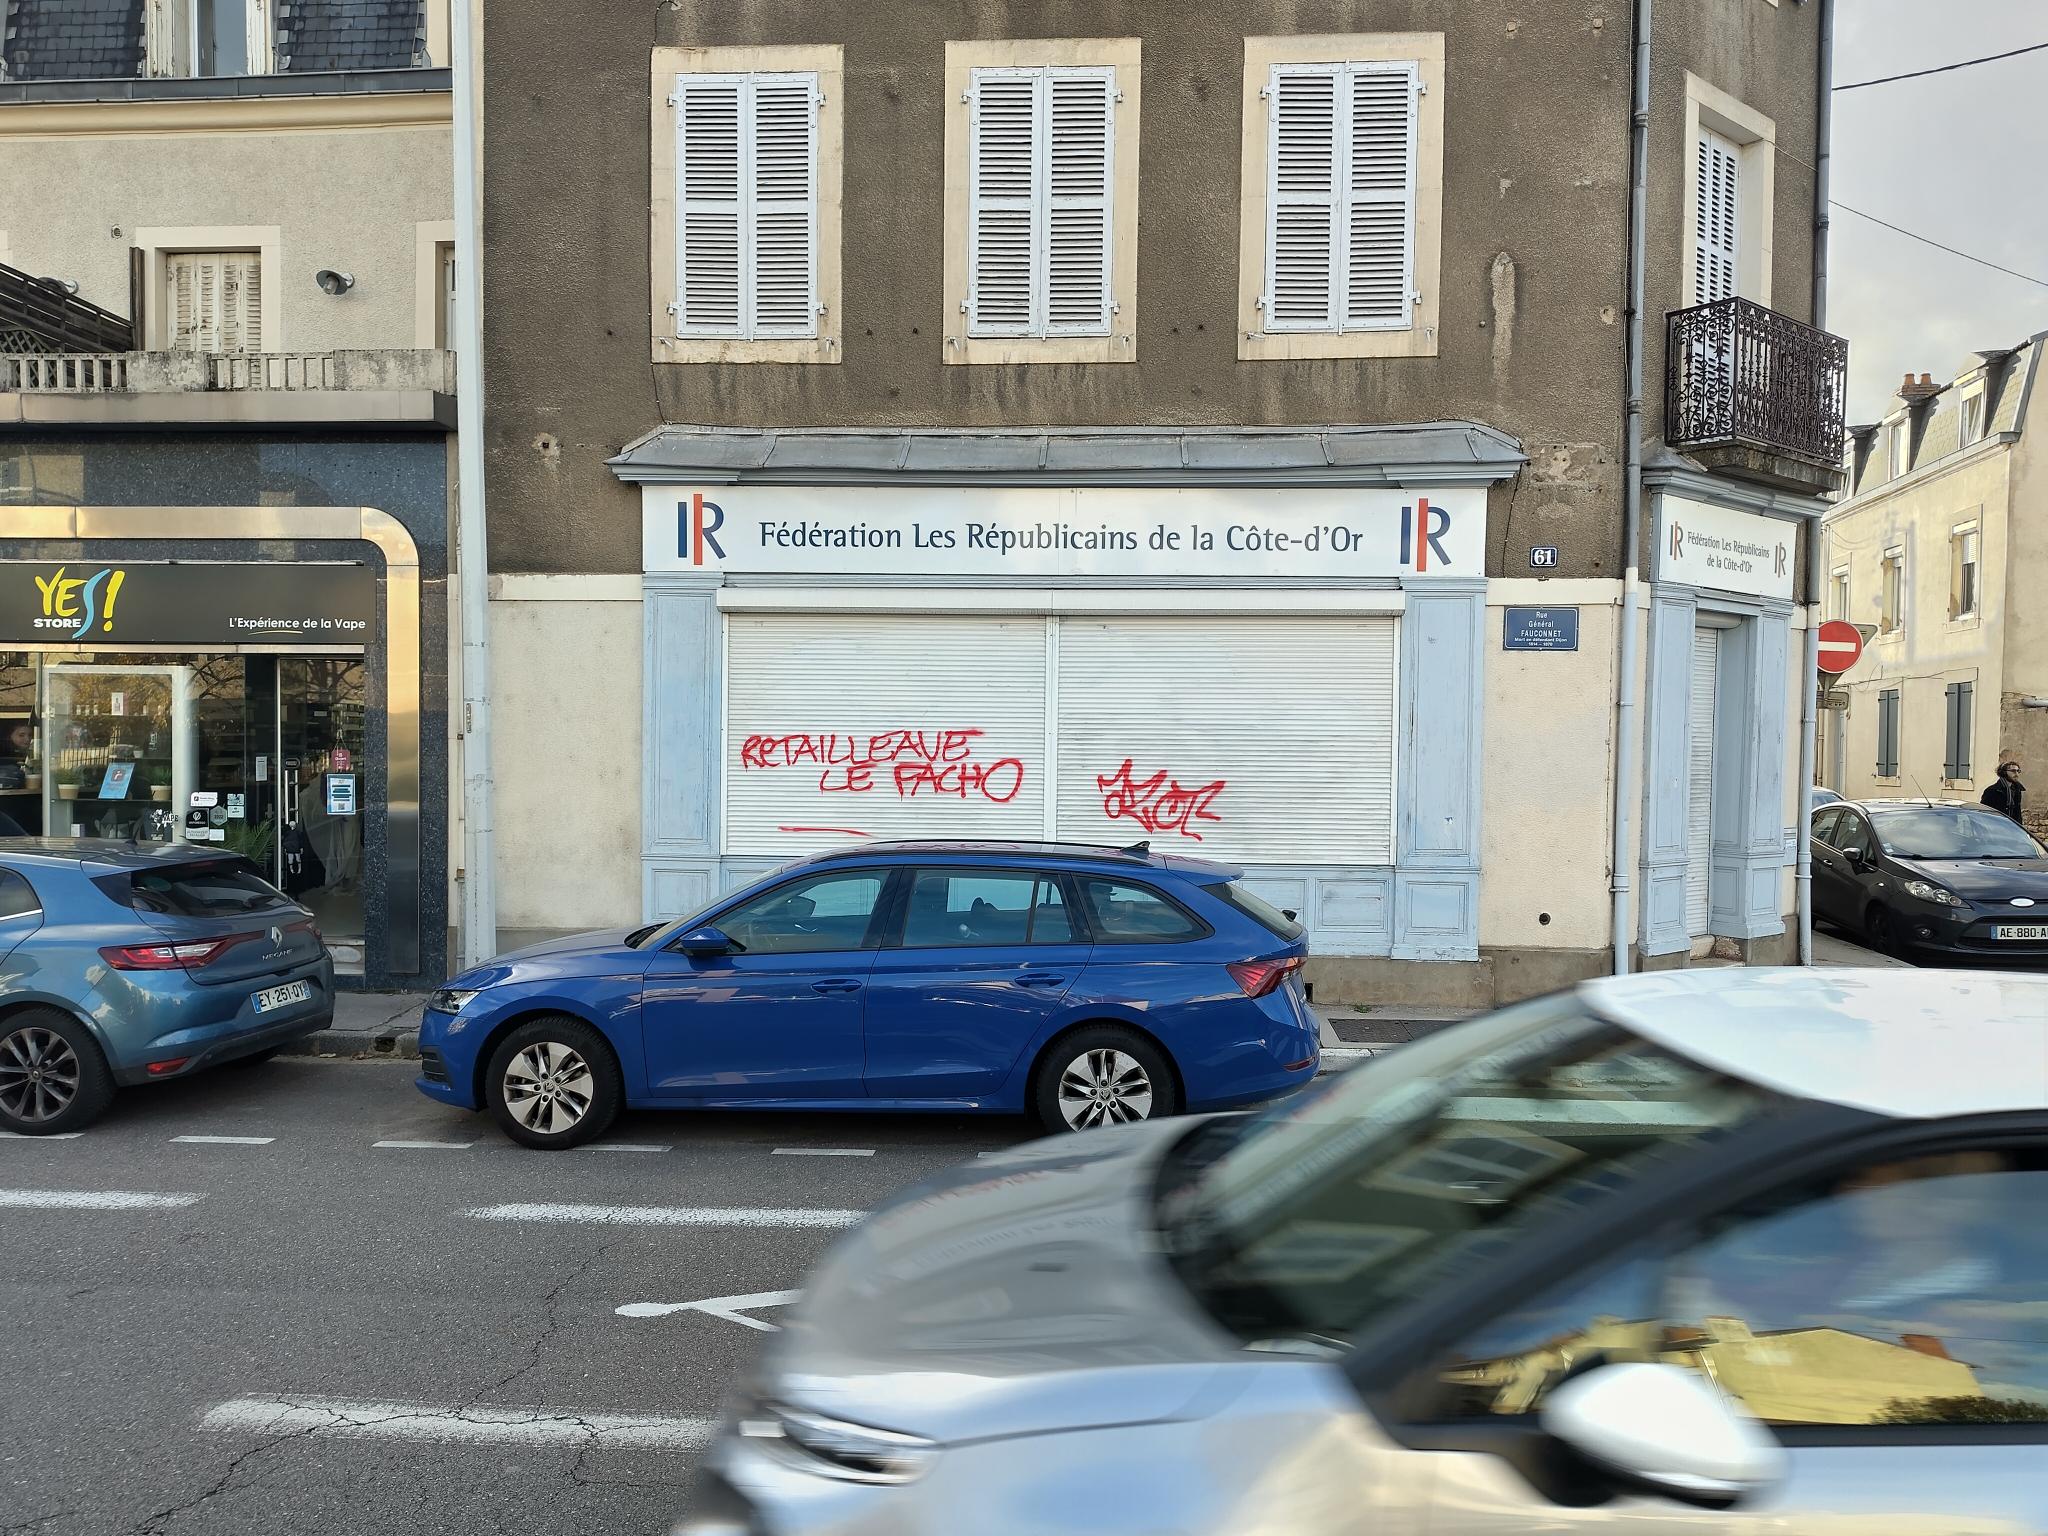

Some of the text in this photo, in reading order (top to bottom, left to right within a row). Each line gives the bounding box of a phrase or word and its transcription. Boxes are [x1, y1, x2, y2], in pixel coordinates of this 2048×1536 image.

[758, 521, 1364, 556] Fédération Les Républicains de la Côte-d'Or
[1687, 531, 1770, 559] Fédération Les Républicains
[1534, 550, 1553, 565] 61
[1706, 554, 1715, 567] de
[1716, 555, 1721, 568] la
[34, 566, 125, 638] YES!
[1535, 611, 1548, 619] Rue
[33, 617, 82, 629] STORE
[229, 617, 366, 632] L'Expérience de la Vape
[1528, 620, 1554, 628] Général
[820, 758, 1024, 802] LE FACHO
[1999, 928, 2048, 938] AE-880-A
